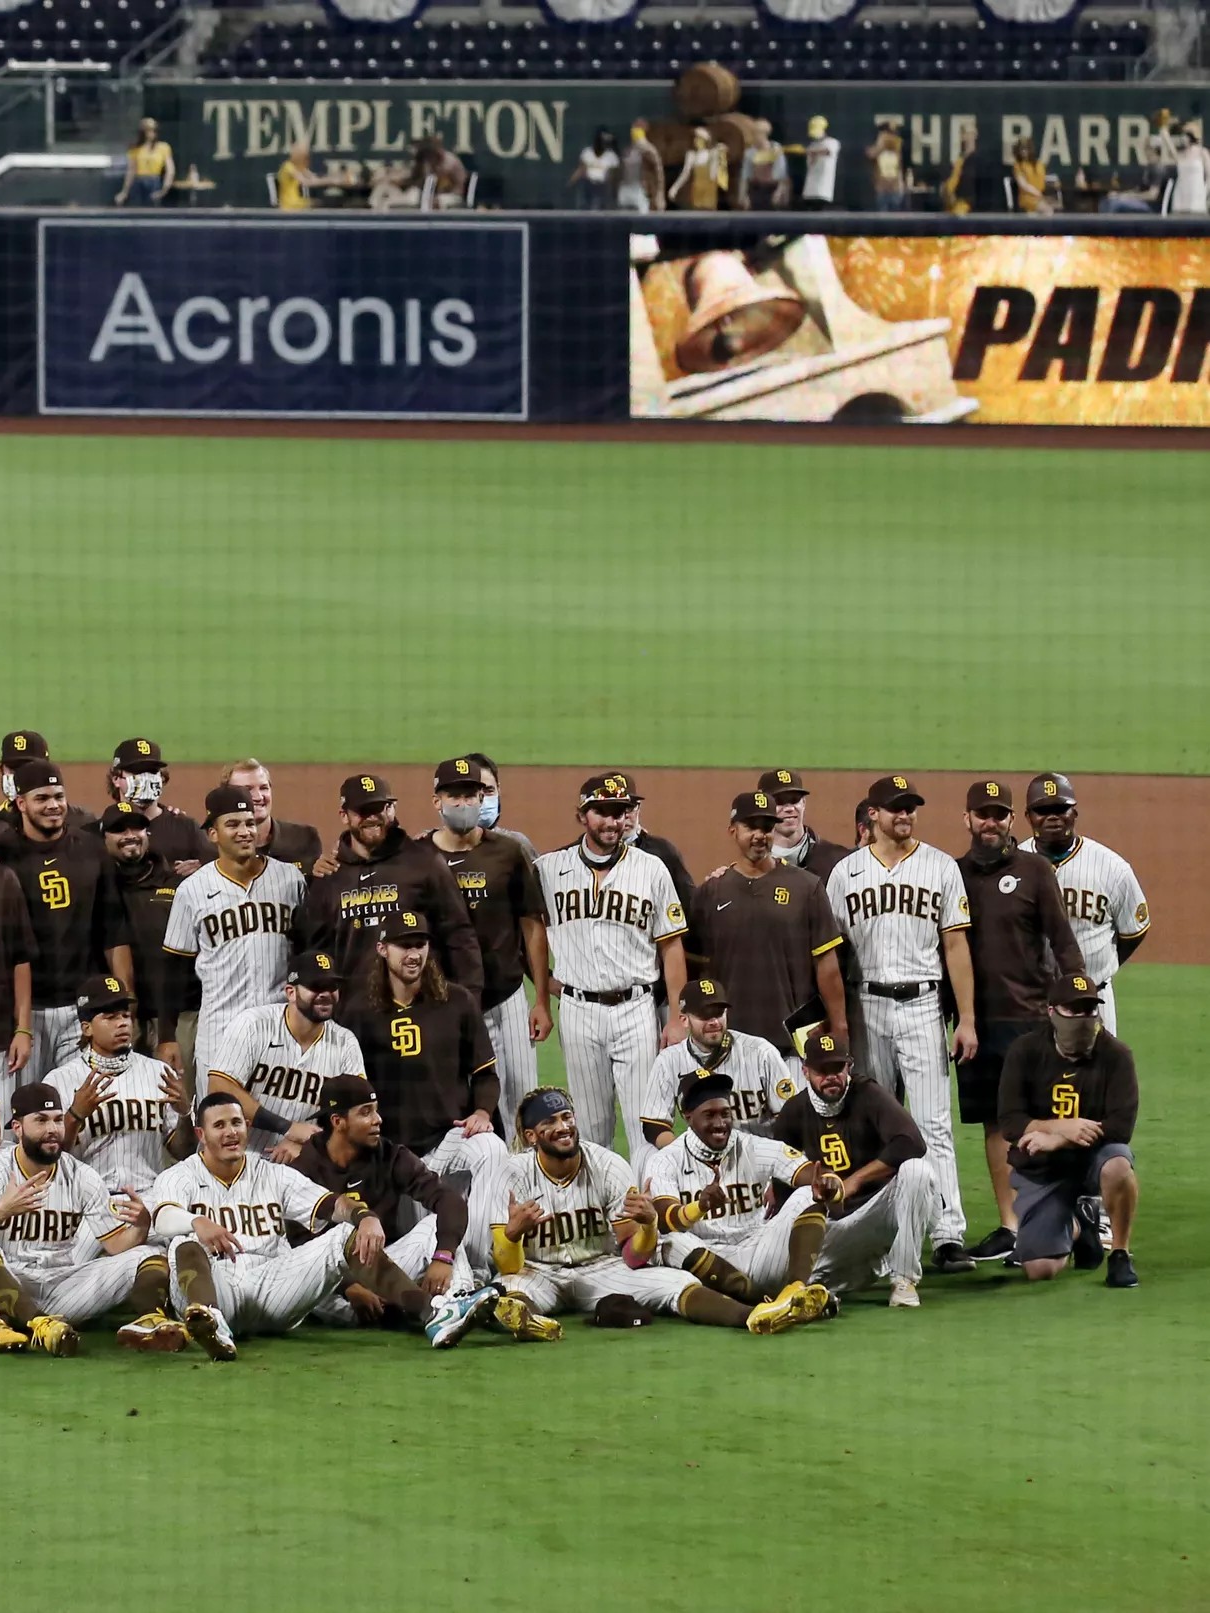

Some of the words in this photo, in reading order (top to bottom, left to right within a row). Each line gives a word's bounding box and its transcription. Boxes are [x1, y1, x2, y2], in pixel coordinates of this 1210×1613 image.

[203, 100, 568, 162] TEMPLETON
[90, 272, 477, 367] Acronis
[13, 735, 27, 751] SD
[136, 740, 151, 755] SD
[456, 760, 470, 775] SD
[361, 777, 375, 791] SD
[777, 770, 792, 784] SD
[893, 776, 908, 790] SD
[987, 783, 999, 796] SD
[1044, 781, 1056, 796] SD
[755, 794, 767, 808] SD
[39, 870, 70, 909] SD
[341, 884, 399, 909] PADRES
[775, 887, 789, 904] SD
[341, 903, 401, 919] BASEBALL
[553, 889, 653, 930] PADRES
[845, 883, 942, 927] PADRES
[202, 902, 291, 948] PADRE
[403, 913, 416, 926] SD
[316, 955, 330, 969] SD
[105, 978, 120, 992] SD
[700, 980, 714, 994] SD
[1073, 977, 1087, 990] SD
[391, 1018, 421, 1056] SD
[822, 1036, 834, 1051] SD
[245, 1063, 322, 1107] PADR
[821, 1133, 852, 1172] SD
